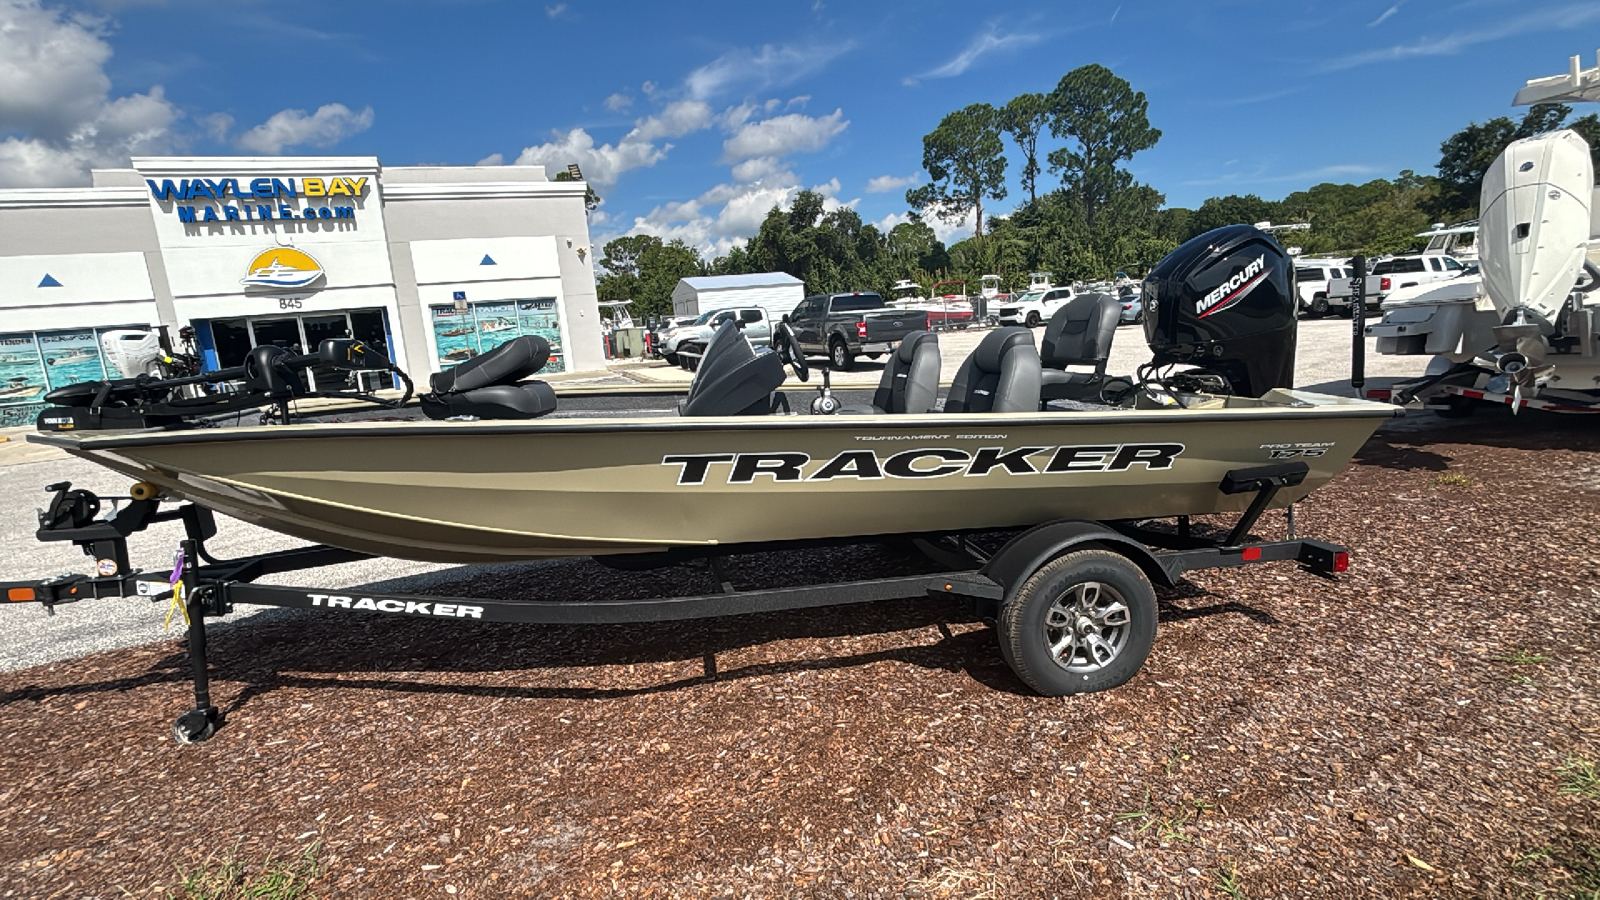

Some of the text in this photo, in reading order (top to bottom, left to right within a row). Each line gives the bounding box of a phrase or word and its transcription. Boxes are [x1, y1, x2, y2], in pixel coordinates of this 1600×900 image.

[147, 177, 368, 200] WAYLEN BAY
[178, 204, 355, 223] MARINE.com
[1196, 253, 1265, 314] MERCURY
[279, 297, 303, 309] 845
[475, 305, 514, 313] TAHOE
[661, 442, 1186, 485] TRACKER
[1268, 447, 1329, 459] 175
[307, 594, 484, 618] TRACKER
